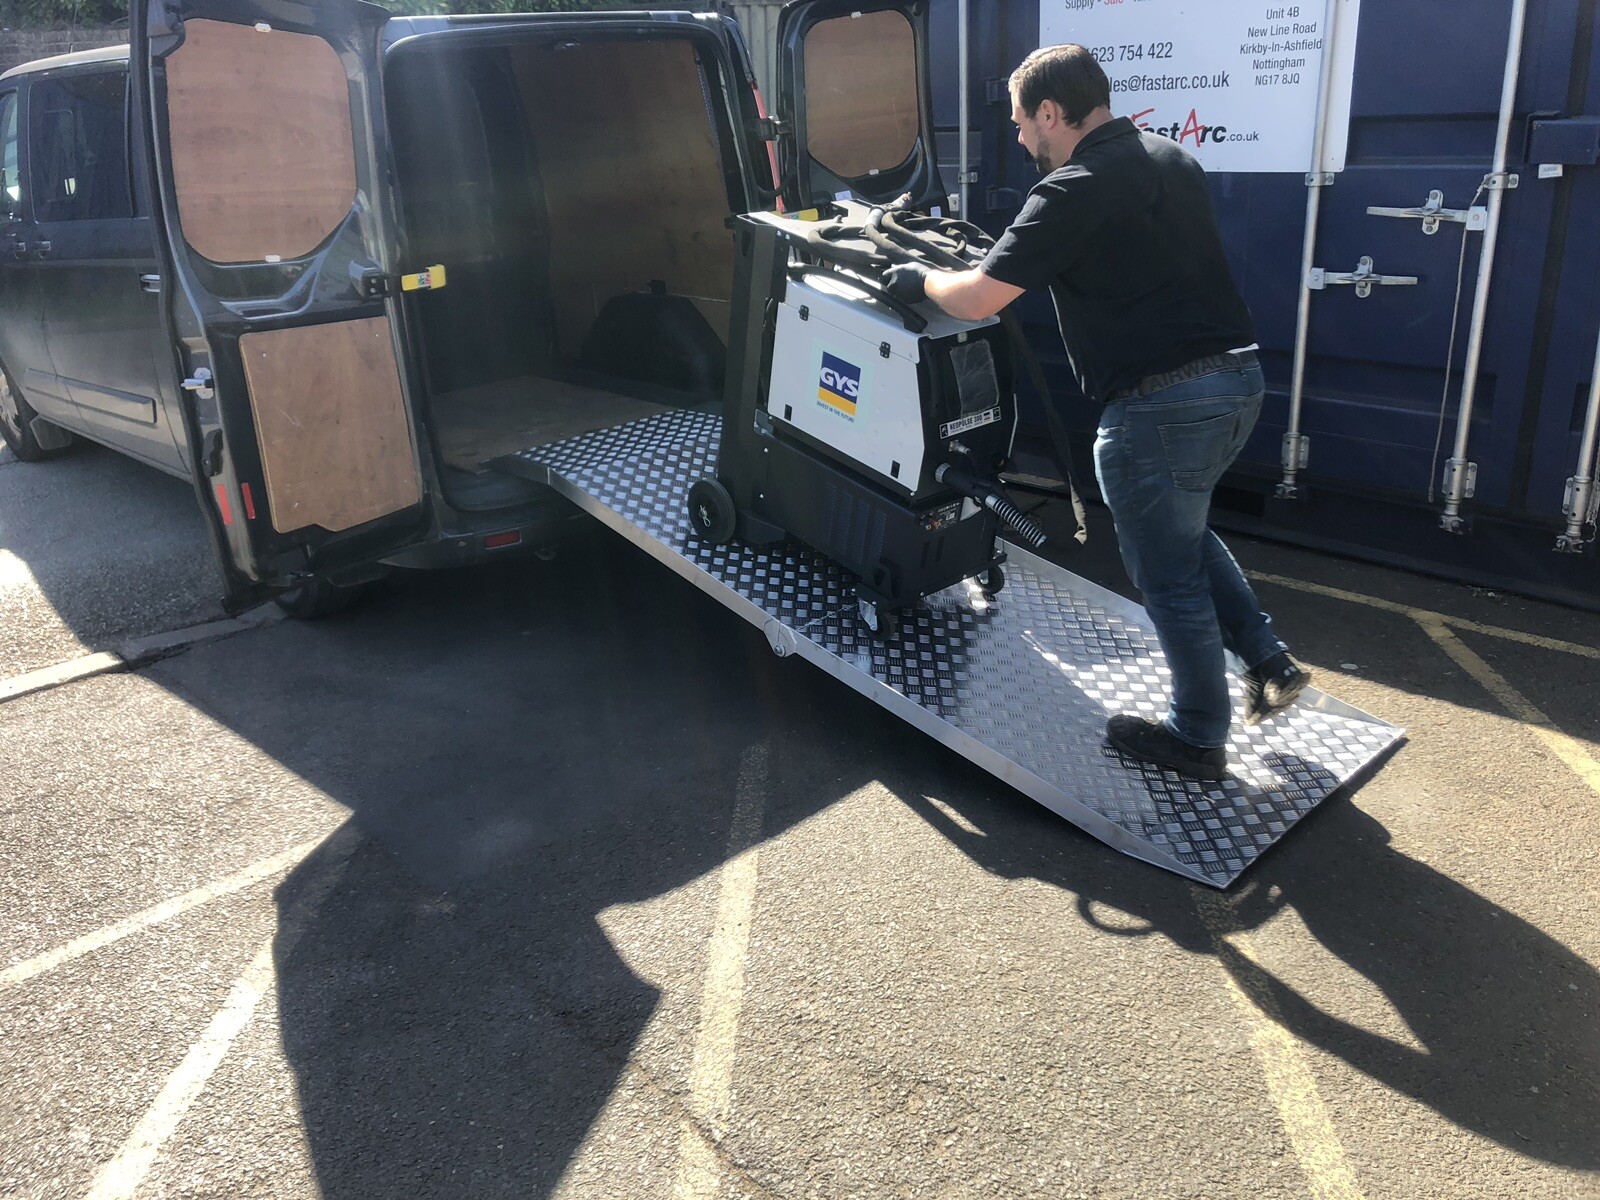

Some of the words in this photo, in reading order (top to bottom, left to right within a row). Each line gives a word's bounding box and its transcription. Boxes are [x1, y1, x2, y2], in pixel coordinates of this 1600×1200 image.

[1065, 0, 1095, 10] Supply
[1266, 8, 1285, 20] Unit
[1287, 6, 1300, 18] 4B
[1247, 27, 1268, 38] New
[1270, 24, 1290, 36] Line
[1292, 22, 1317, 34] Road
[1086, 46, 1115, 62] 623
[1119, 44, 1143, 61] 754
[1147, 41, 1173, 59] 422
[1239, 38, 1323, 55] Kirkby-In-Ashfield
[1252, 57, 1306, 71] Nottingham
[1109, 70, 1230, 93] les@fastarc.co.uk
[1255, 74, 1280, 86] NG17
[1281, 72, 1300, 85] 8JQ
[1131, 107, 1259, 148] FstArc.co.uk
[820, 367, 858, 397] GYS
[949, 416, 973, 431] NEOPULSE
